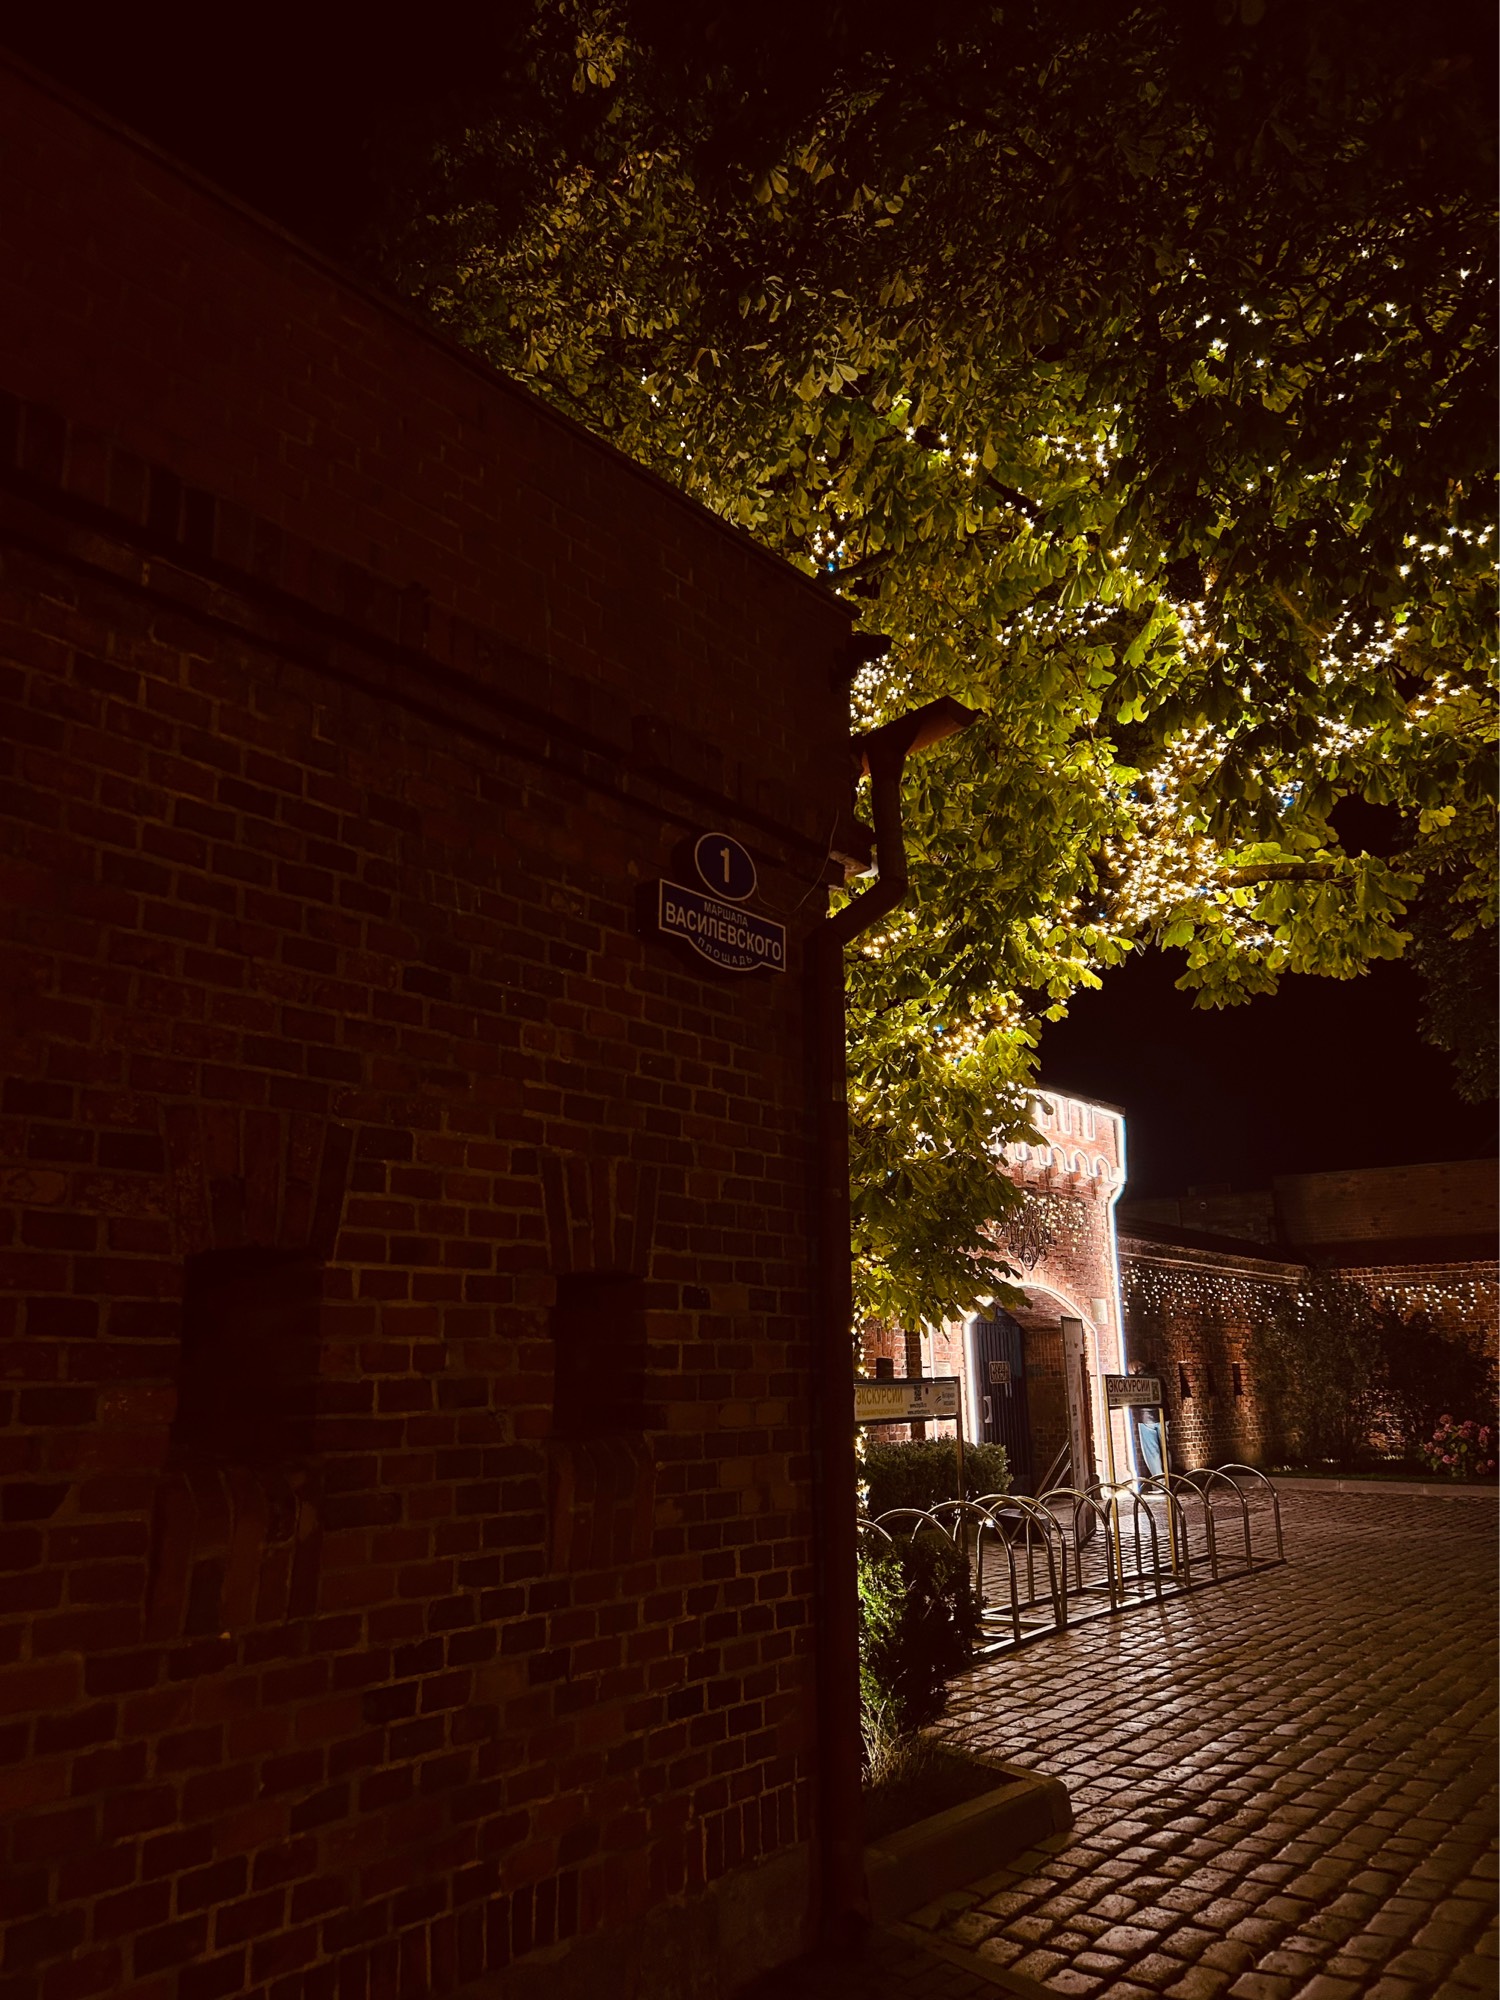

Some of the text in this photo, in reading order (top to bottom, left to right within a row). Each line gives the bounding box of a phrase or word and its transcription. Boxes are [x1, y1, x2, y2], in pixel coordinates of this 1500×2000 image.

[720, 847, 730, 883] 1
[704, 901, 748, 927] МАРШАЛА
[665, 901, 782, 961] ВАСИЛЕВСКОГО
[697, 937, 753, 966] ПЛОЩАДЬ
[856, 1387, 904, 1405] ЭКСКУРСИИ
[1108, 1379, 1151, 1393] ЭКСКУРСИИ
